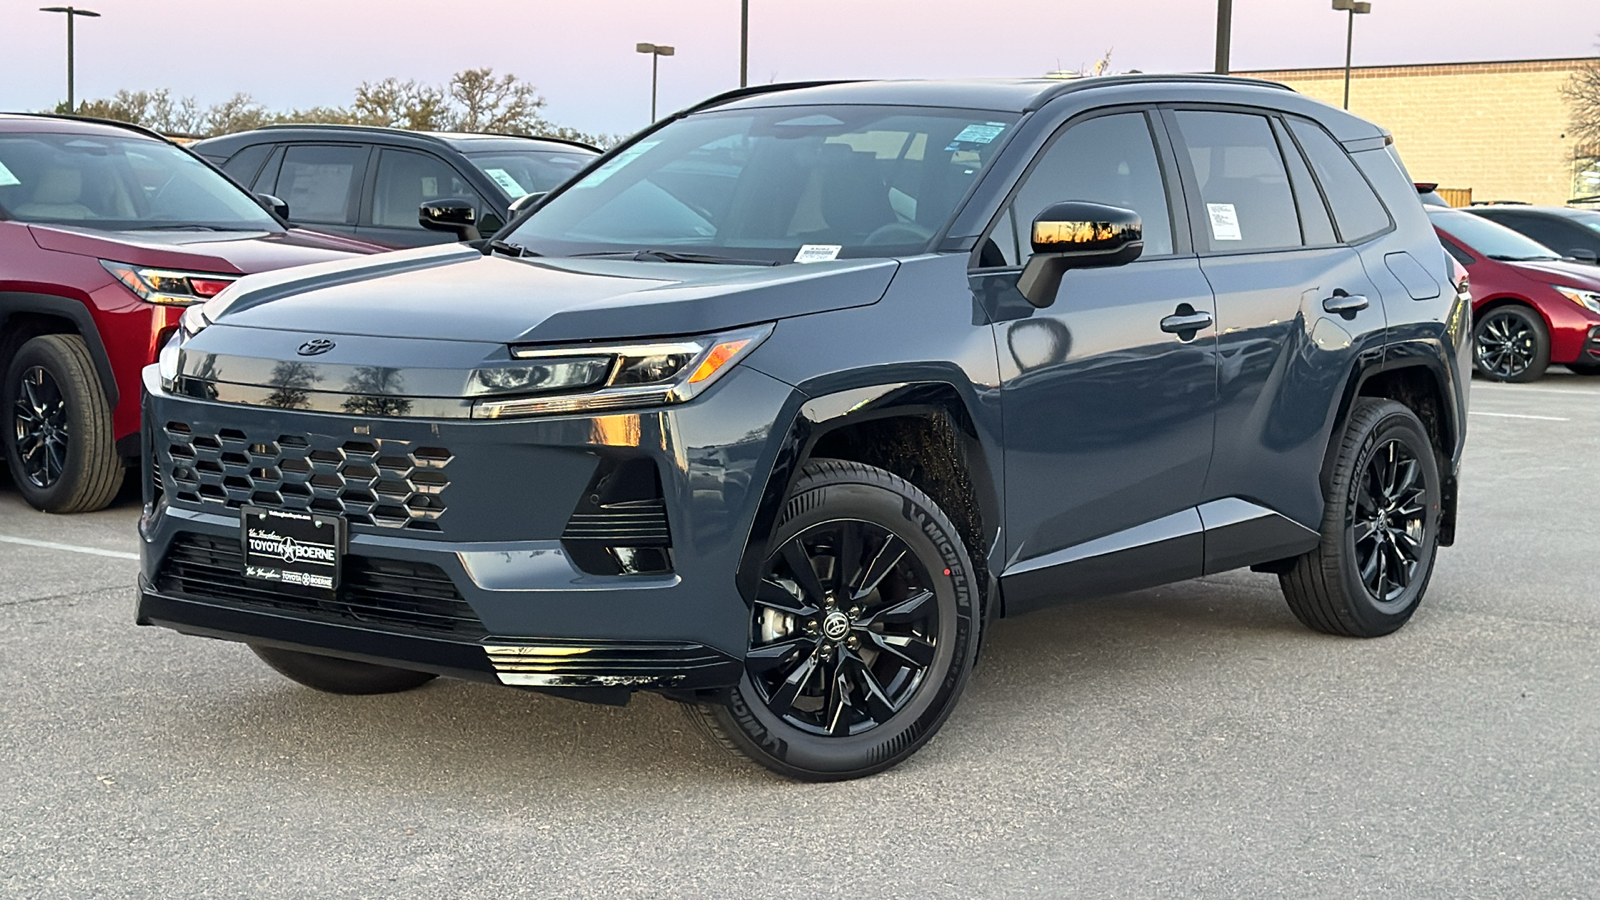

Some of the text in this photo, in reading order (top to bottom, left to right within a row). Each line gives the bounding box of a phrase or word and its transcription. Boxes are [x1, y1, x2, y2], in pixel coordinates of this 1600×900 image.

[249, 539, 335, 560] TOYOTA BOERNE
[924, 522, 970, 608] MICHELIN
[730, 687, 765, 738] MICH
